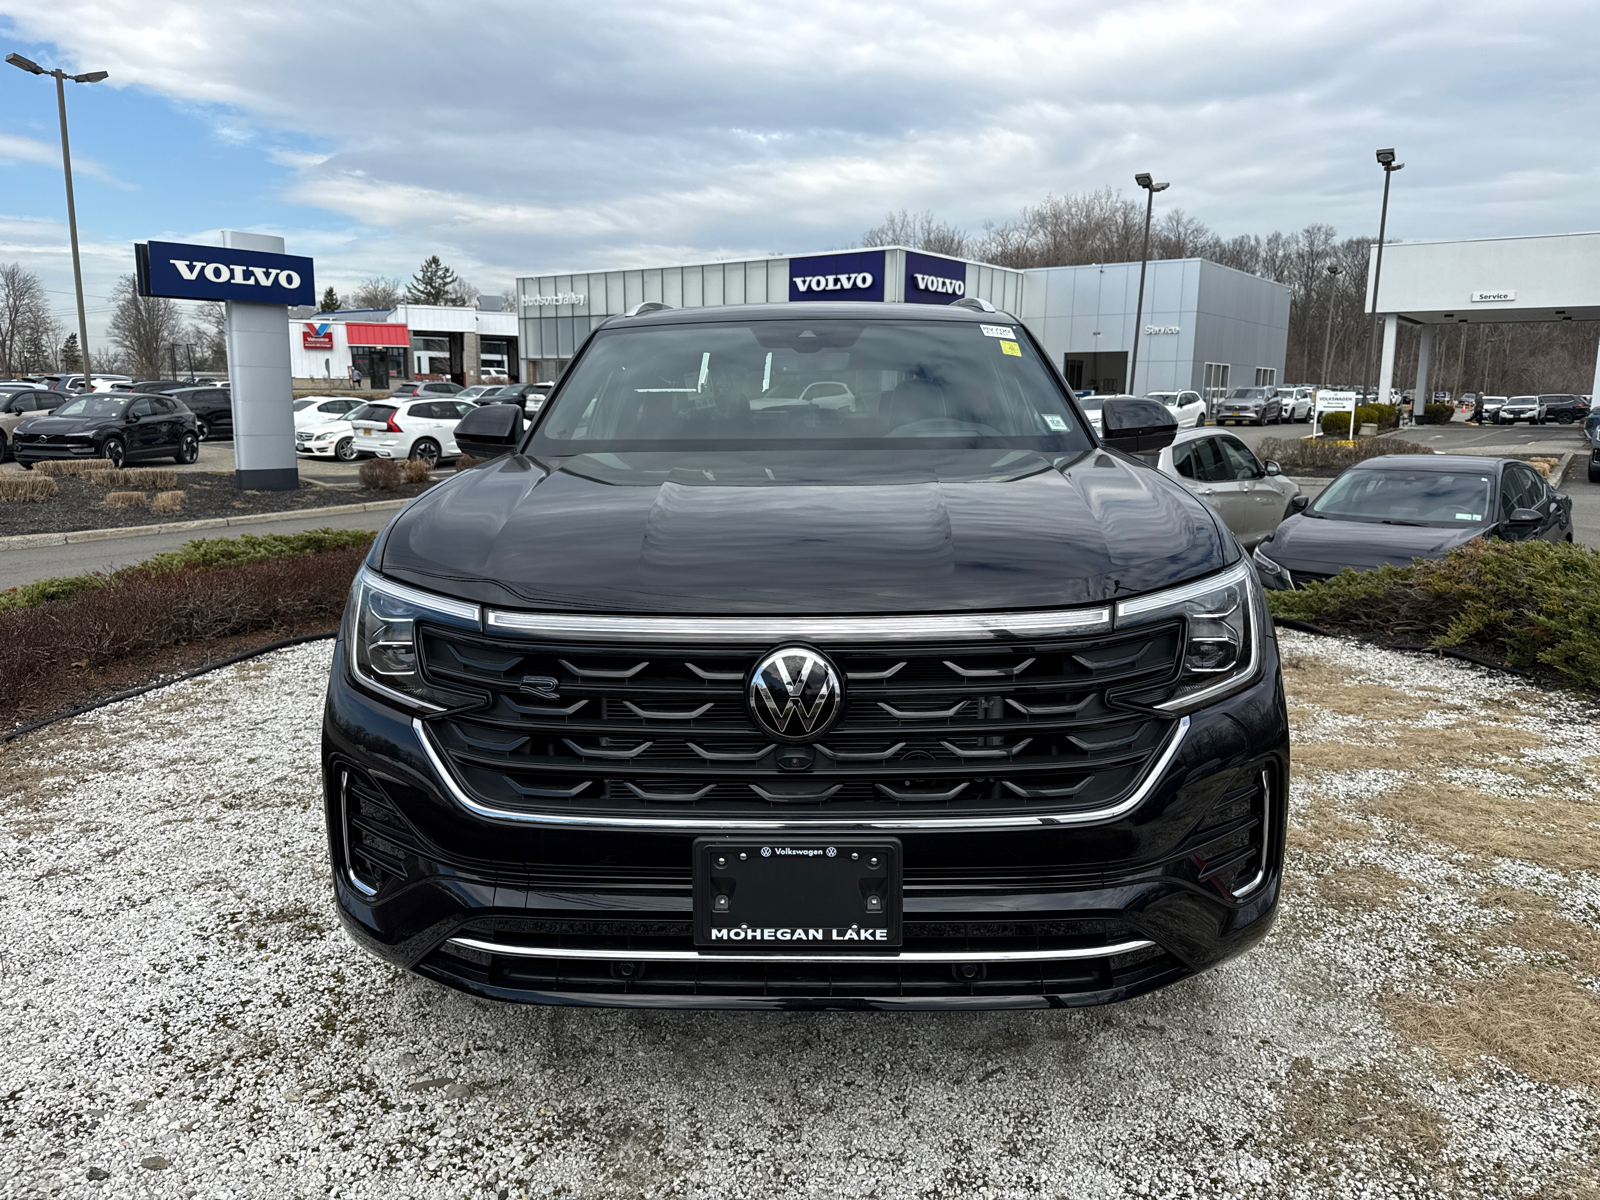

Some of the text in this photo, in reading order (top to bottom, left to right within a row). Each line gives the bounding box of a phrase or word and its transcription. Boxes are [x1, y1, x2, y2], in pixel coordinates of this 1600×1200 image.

[170, 259, 301, 290] VOLVO
[793, 272, 873, 292] VOLVO
[914, 273, 965, 295] VOLVO
[521, 292, 586, 306] Hudson Valley
[1145, 325, 1179, 335] Service
[774, 847, 824, 857] Volkswagen
[711, 928, 888, 941] MOHEGAN LAKE
